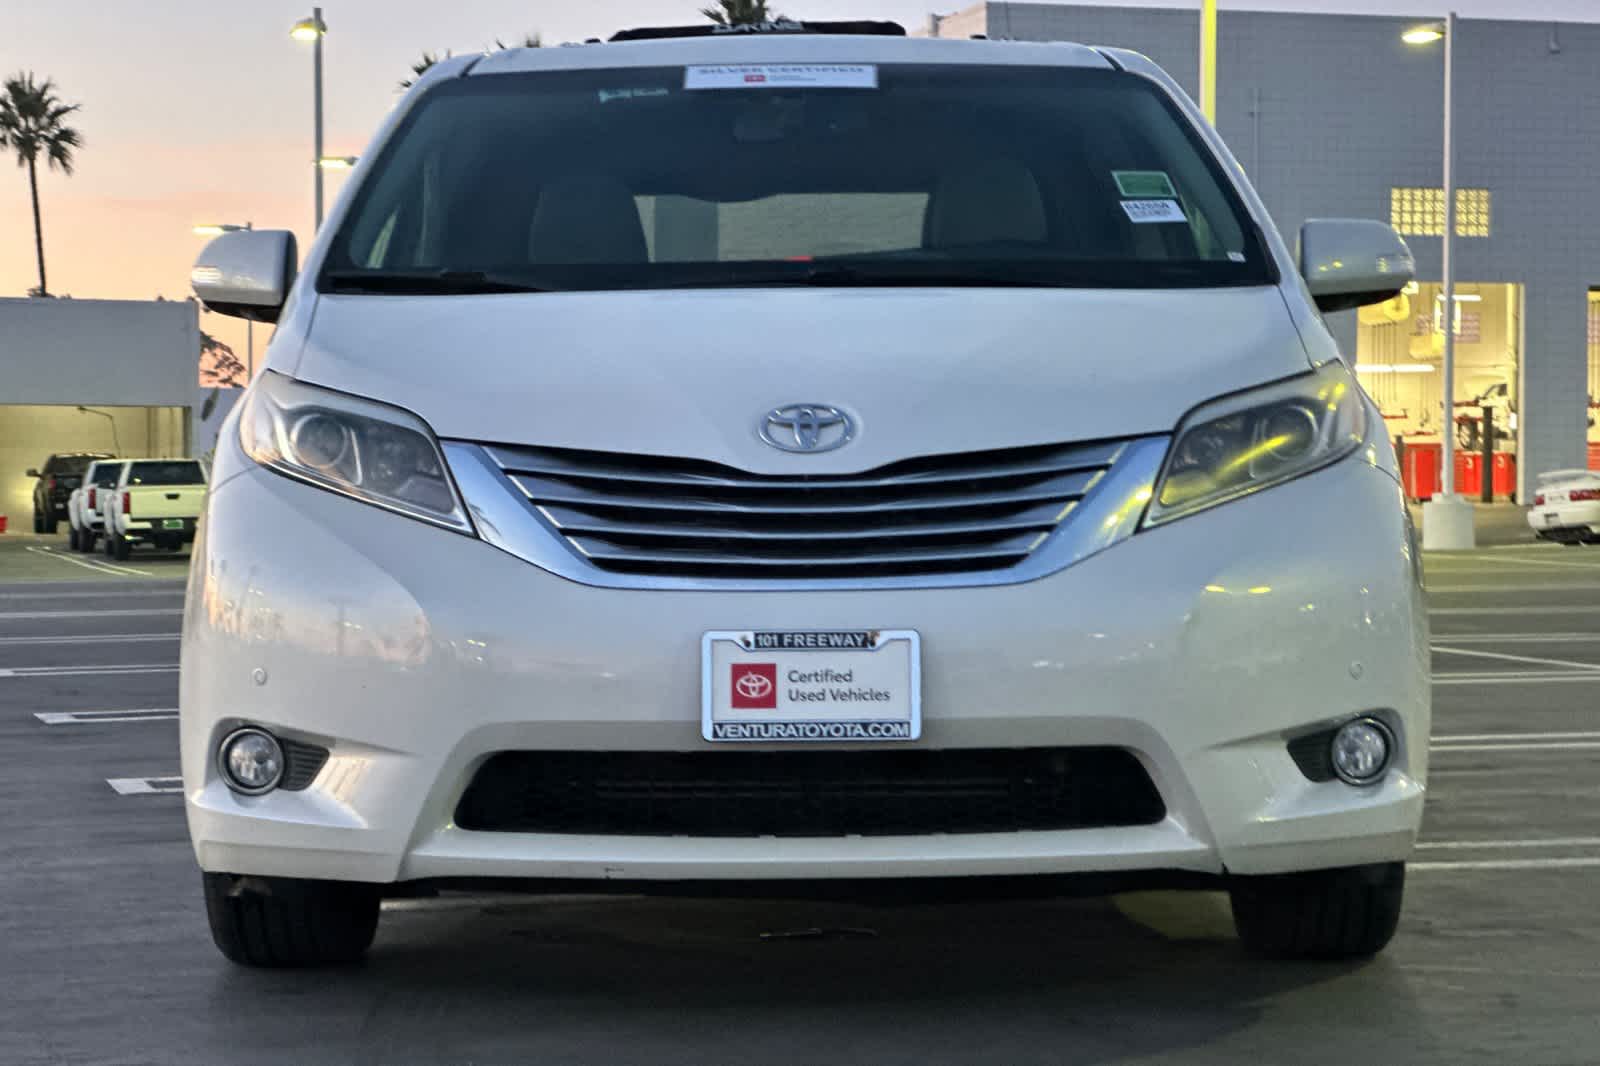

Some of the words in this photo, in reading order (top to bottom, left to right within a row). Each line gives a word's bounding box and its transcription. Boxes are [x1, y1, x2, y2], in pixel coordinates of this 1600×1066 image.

[757, 634, 778, 646] 101
[783, 633, 865, 647] FREEWAY
[787, 669, 853, 683] Certified
[787, 688, 826, 702] Used
[831, 688, 891, 702] Vehicles
[714, 724, 909, 738] VENTURATOYOTA.COM
